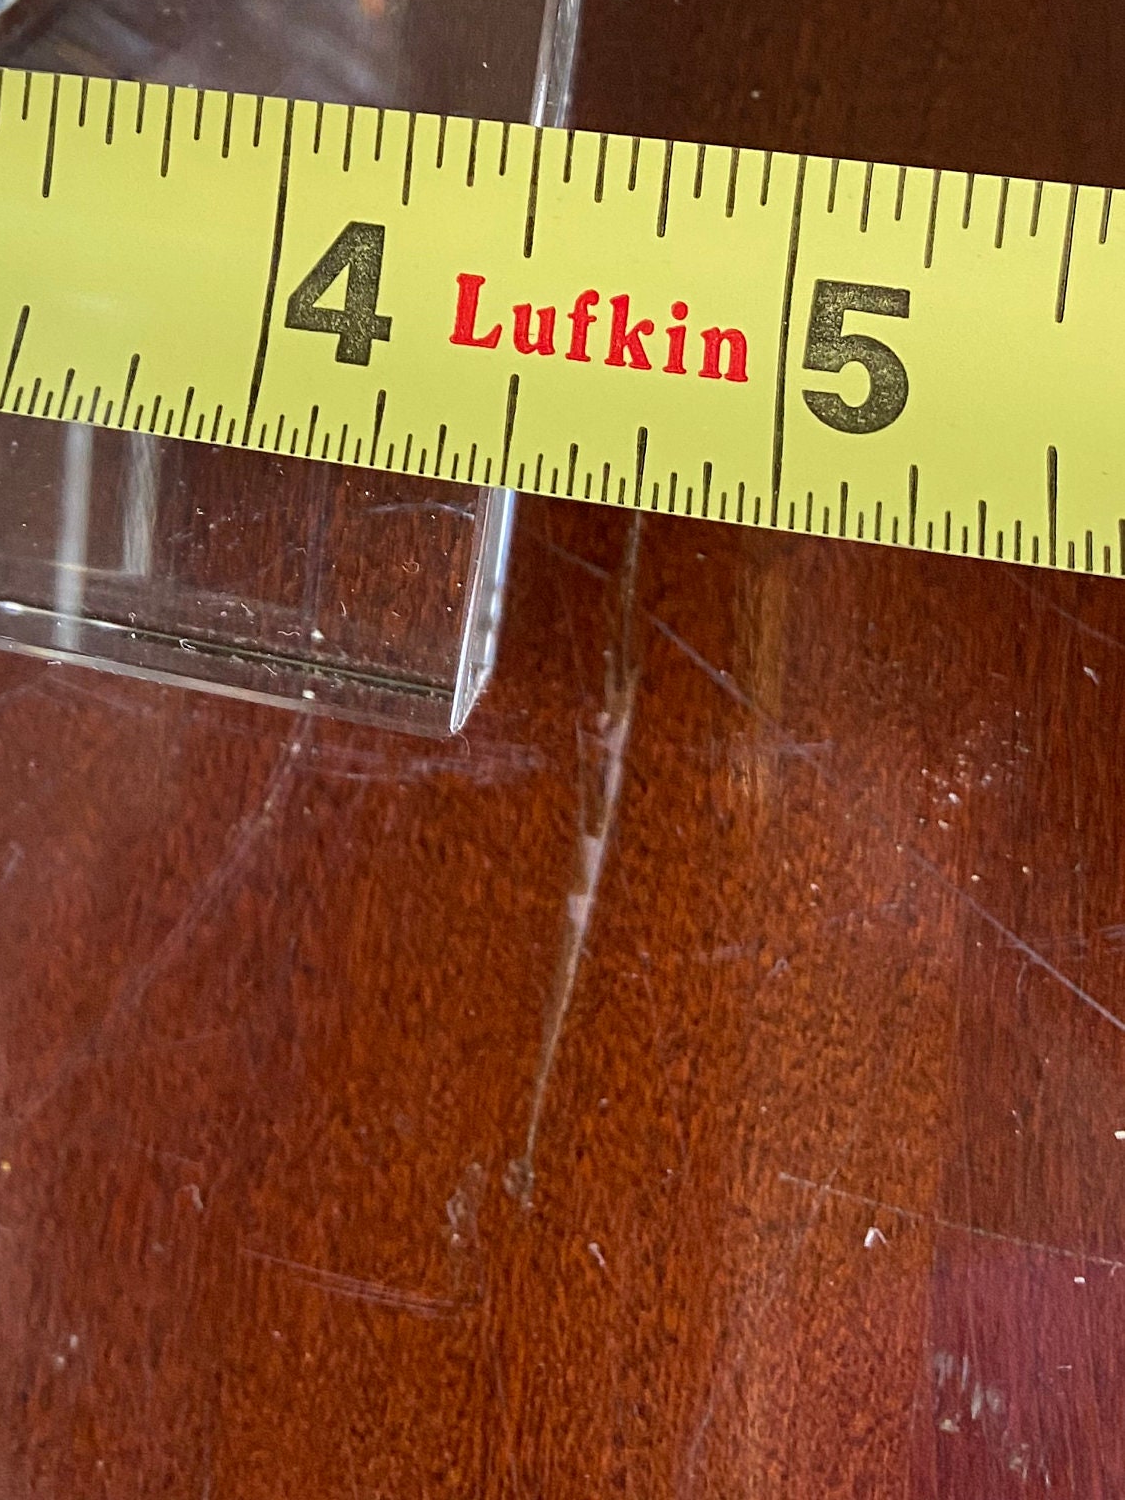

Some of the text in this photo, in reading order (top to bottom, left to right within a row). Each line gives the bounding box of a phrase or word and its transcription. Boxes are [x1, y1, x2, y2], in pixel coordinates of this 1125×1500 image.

[284, 221, 392, 366] 4
[448, 273, 749, 383] Lufkin
[800, 278, 912, 434] 5
